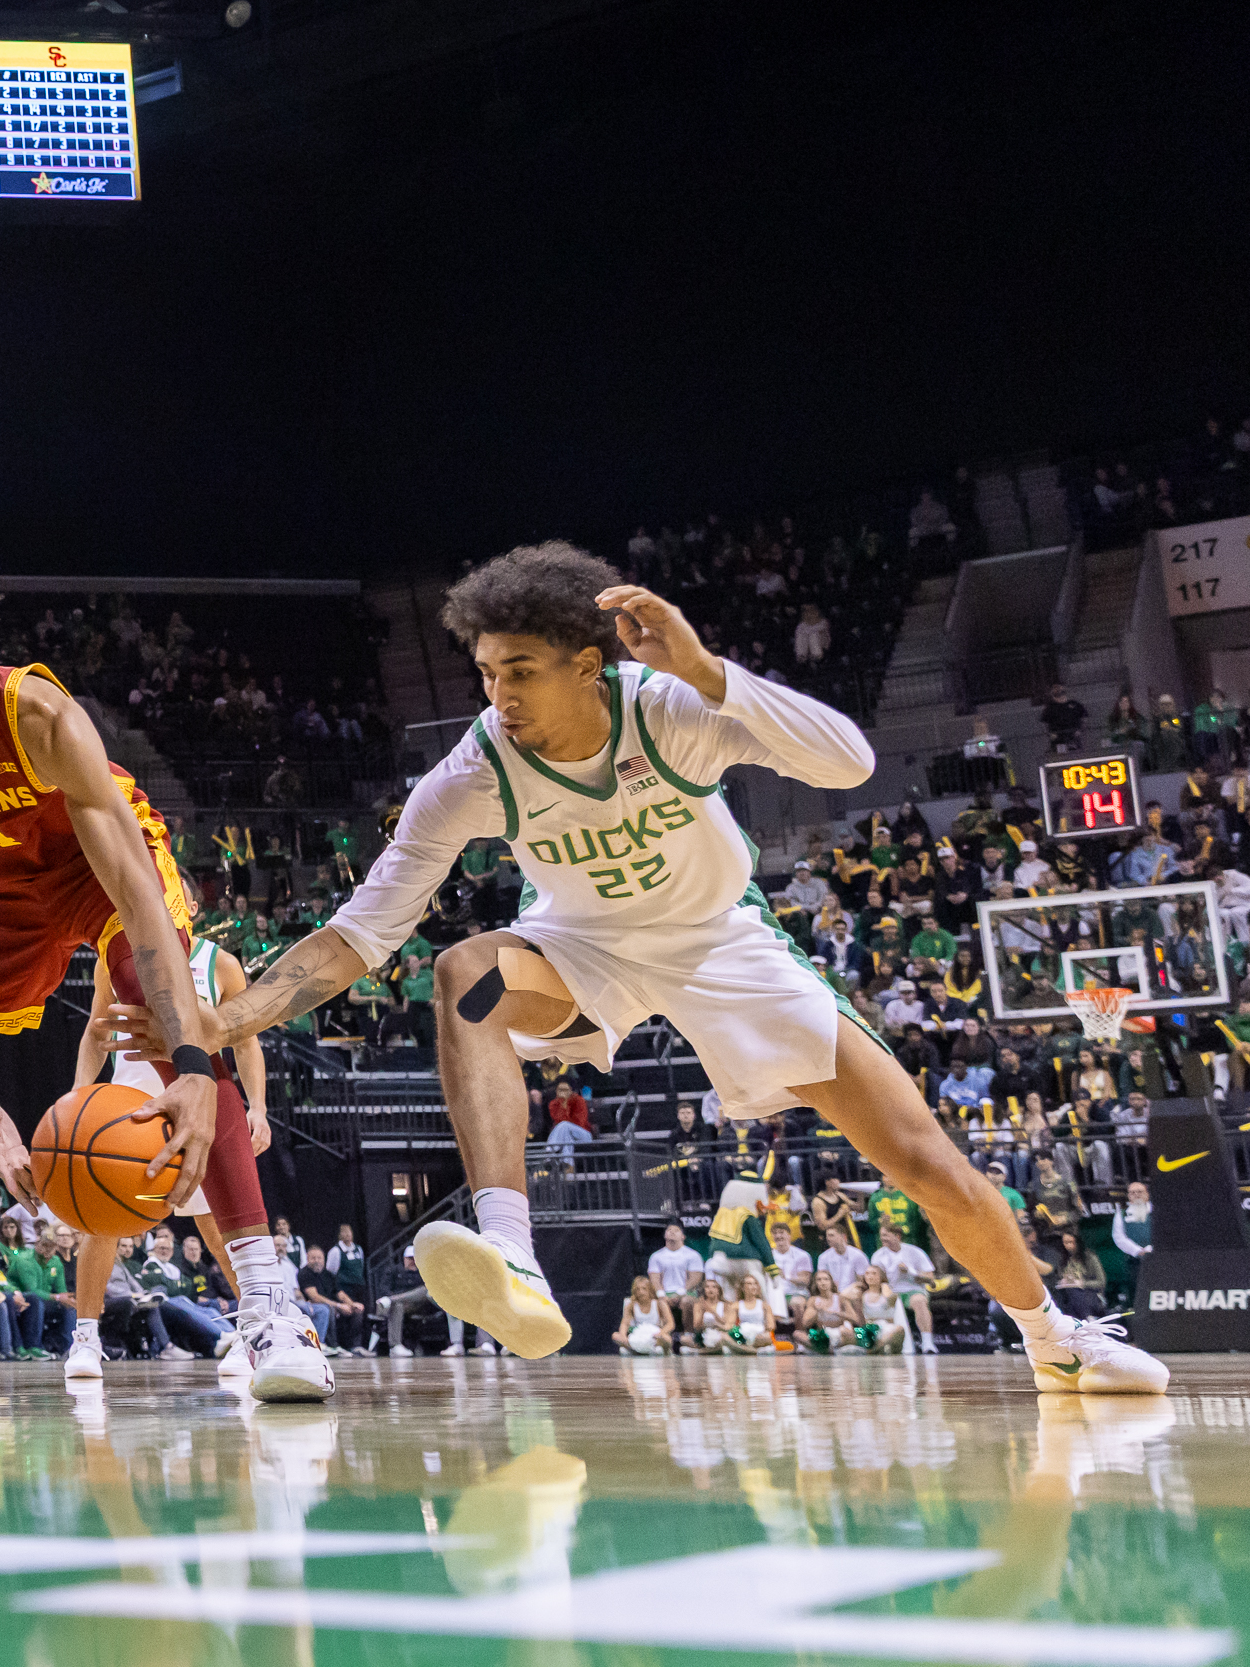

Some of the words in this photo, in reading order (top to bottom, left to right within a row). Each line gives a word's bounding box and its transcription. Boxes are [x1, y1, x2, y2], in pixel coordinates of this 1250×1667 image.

[25, 72, 40, 81] PTS
[77, 73, 93, 82] AST
[110, 74, 116, 83] F
[3, 87, 10, 97] 2
[30, 87, 37, 98] 6
[85, 89, 90, 98] 1
[109, 90, 116, 100] 2
[3, 104, 12, 115] 4
[29, 104, 40, 115] 14
[57, 105, 65, 115] 4
[85, 106, 92, 116] 3
[110, 106, 117, 117] 2
[5, 120, 12, 131] 6
[31, 121, 40, 131] 17
[59, 121, 65, 132] 2
[111, 122, 118, 133] 2
[33, 138, 40, 148] 7
[60, 138, 67, 149] 3
[88, 139, 93, 150] 1
[1170, 538, 1218, 563] 217
[1177, 578, 1220, 600] 117
[1063, 761, 1126, 789] 10:43
[1082, 790, 1124, 828] 14
[527, 796, 696, 865] DUCKS
[588, 853, 671, 899] 22
[1091, 1202, 1116, 1214] BEL
[680, 1216, 712, 1227] TACO
